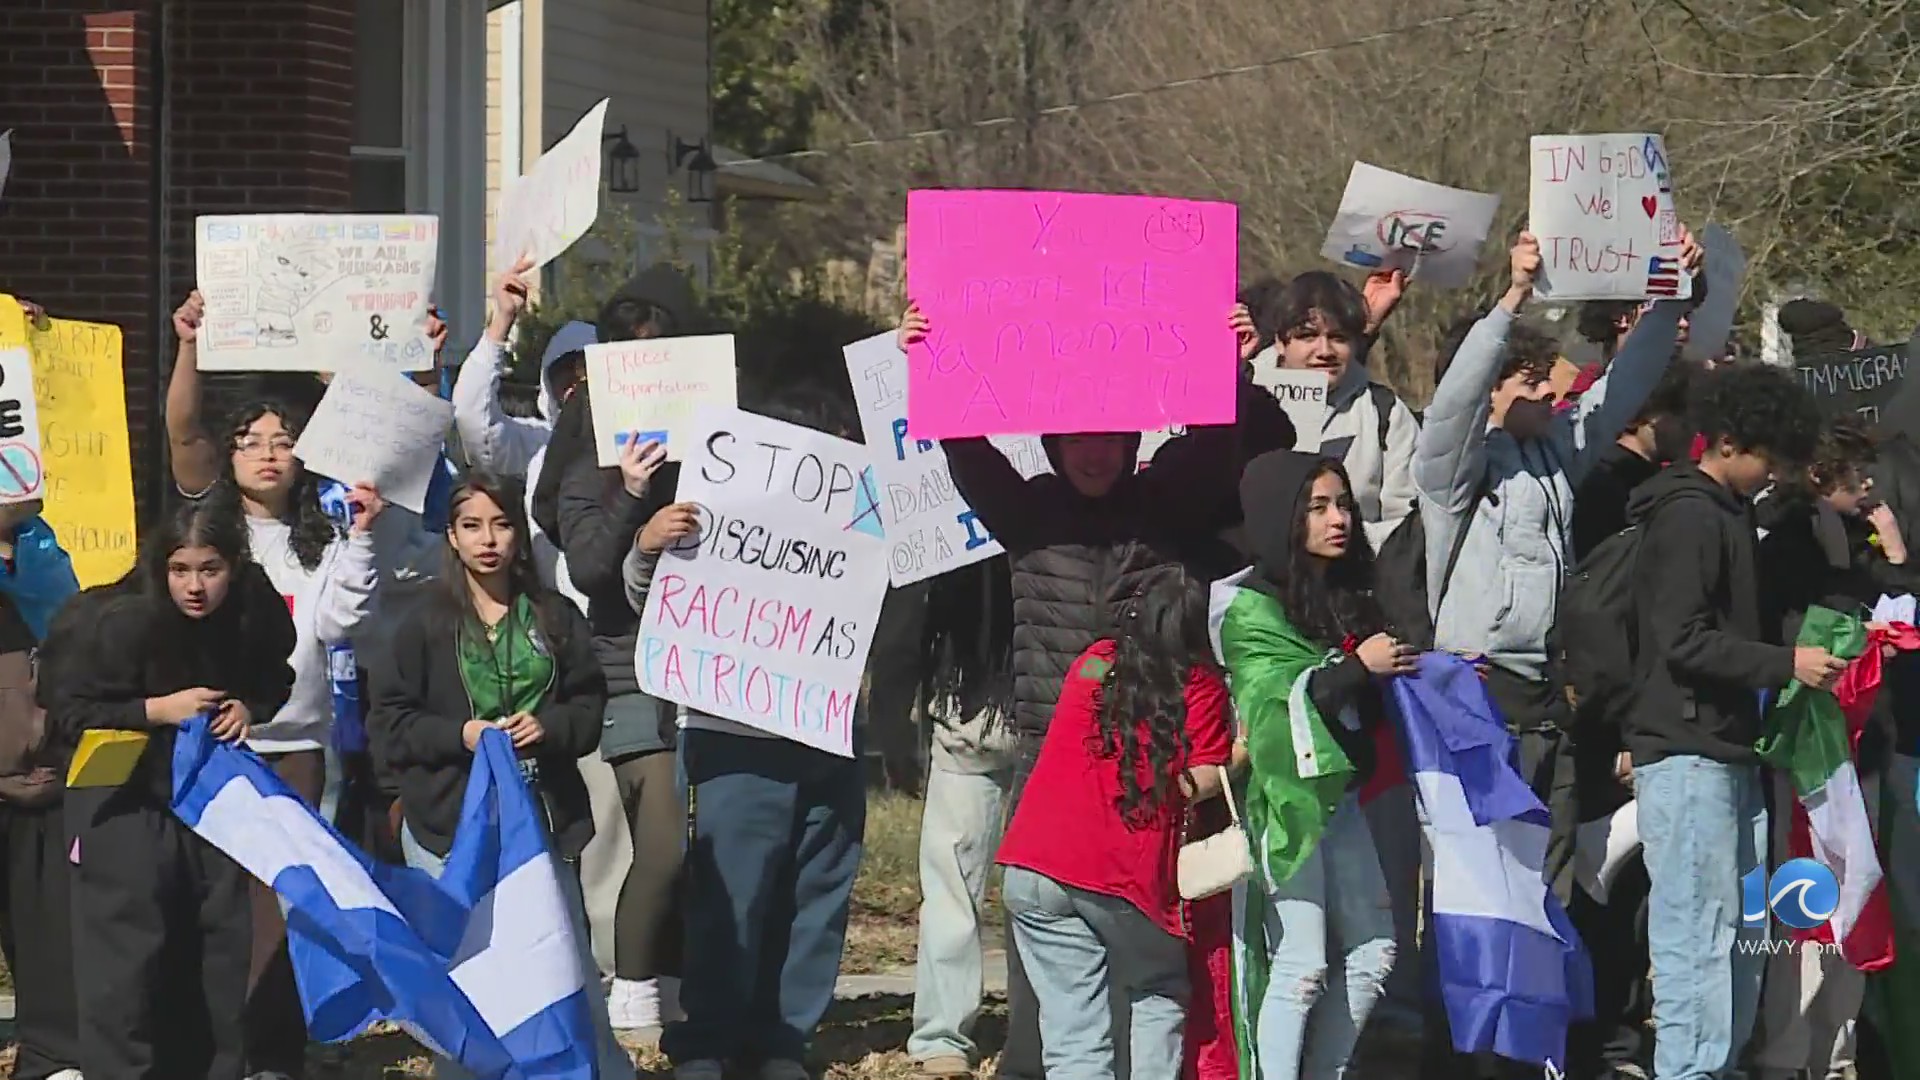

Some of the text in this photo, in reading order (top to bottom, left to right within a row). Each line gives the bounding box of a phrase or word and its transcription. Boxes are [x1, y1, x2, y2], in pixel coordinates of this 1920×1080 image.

[1537, 145, 1585, 182] IN
[1387, 216, 1447, 254] ICE
[369, 313, 391, 341] &
[961, 375, 1008, 423] A
[1273, 382, 1323, 403] more
[701, 431, 854, 514] STOP
[892, 528, 927, 575] OF
[935, 525, 953, 563] A
[657, 574, 857, 661] RACISM AS
[643, 636, 852, 747] PATRIOTISM
